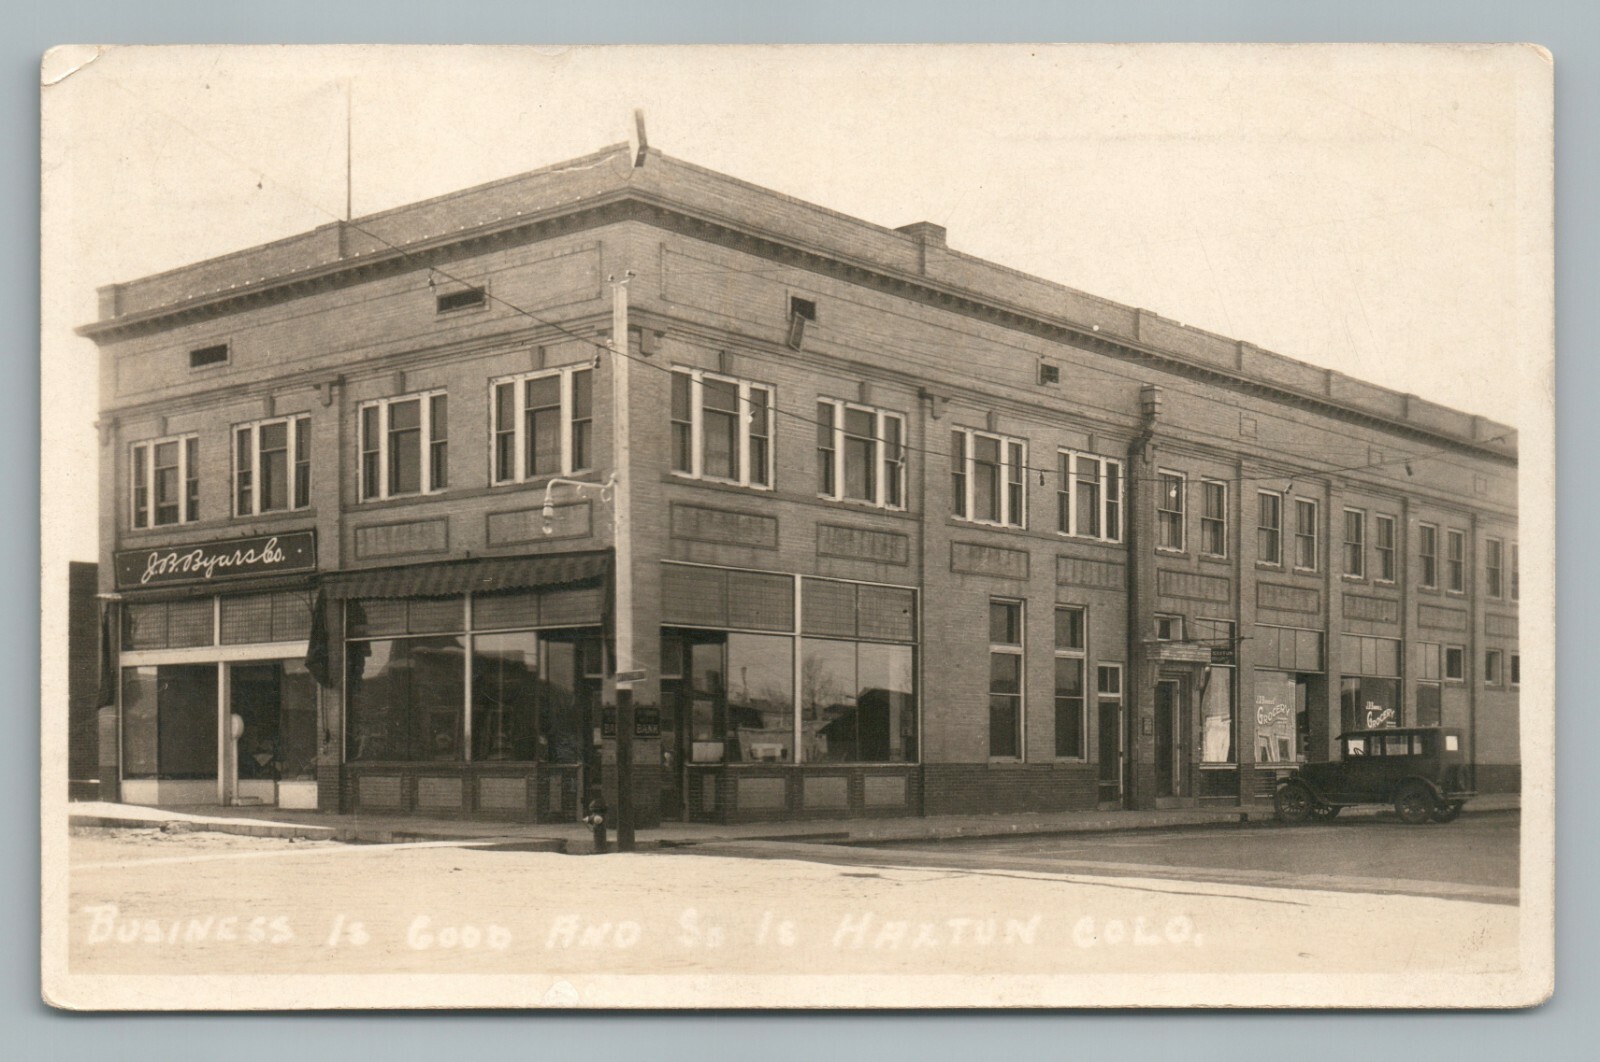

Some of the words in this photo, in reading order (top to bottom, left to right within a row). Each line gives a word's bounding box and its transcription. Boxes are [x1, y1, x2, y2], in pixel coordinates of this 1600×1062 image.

[1257, 703, 1290, 725] GROCERY
[1366, 710, 1395, 729] GROCERY
[636, 723, 659, 734] BANK
